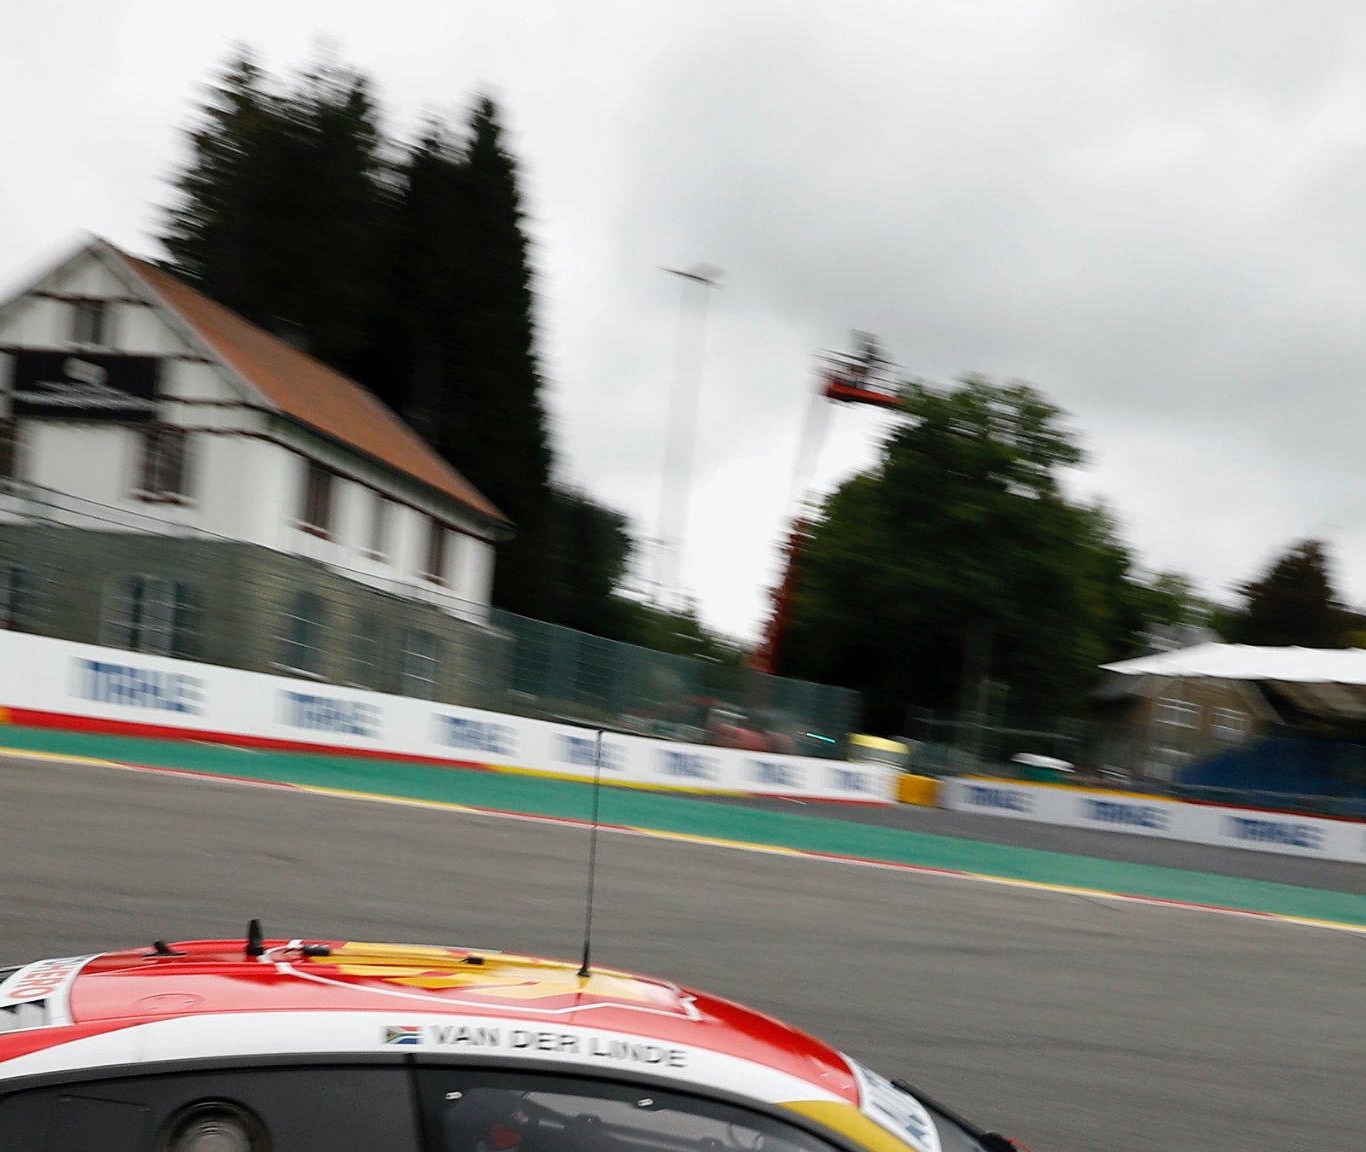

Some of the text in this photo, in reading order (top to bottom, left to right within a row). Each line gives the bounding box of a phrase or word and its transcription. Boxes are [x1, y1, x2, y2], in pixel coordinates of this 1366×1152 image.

[430, 1024, 687, 1069] VAN DER LINDE
